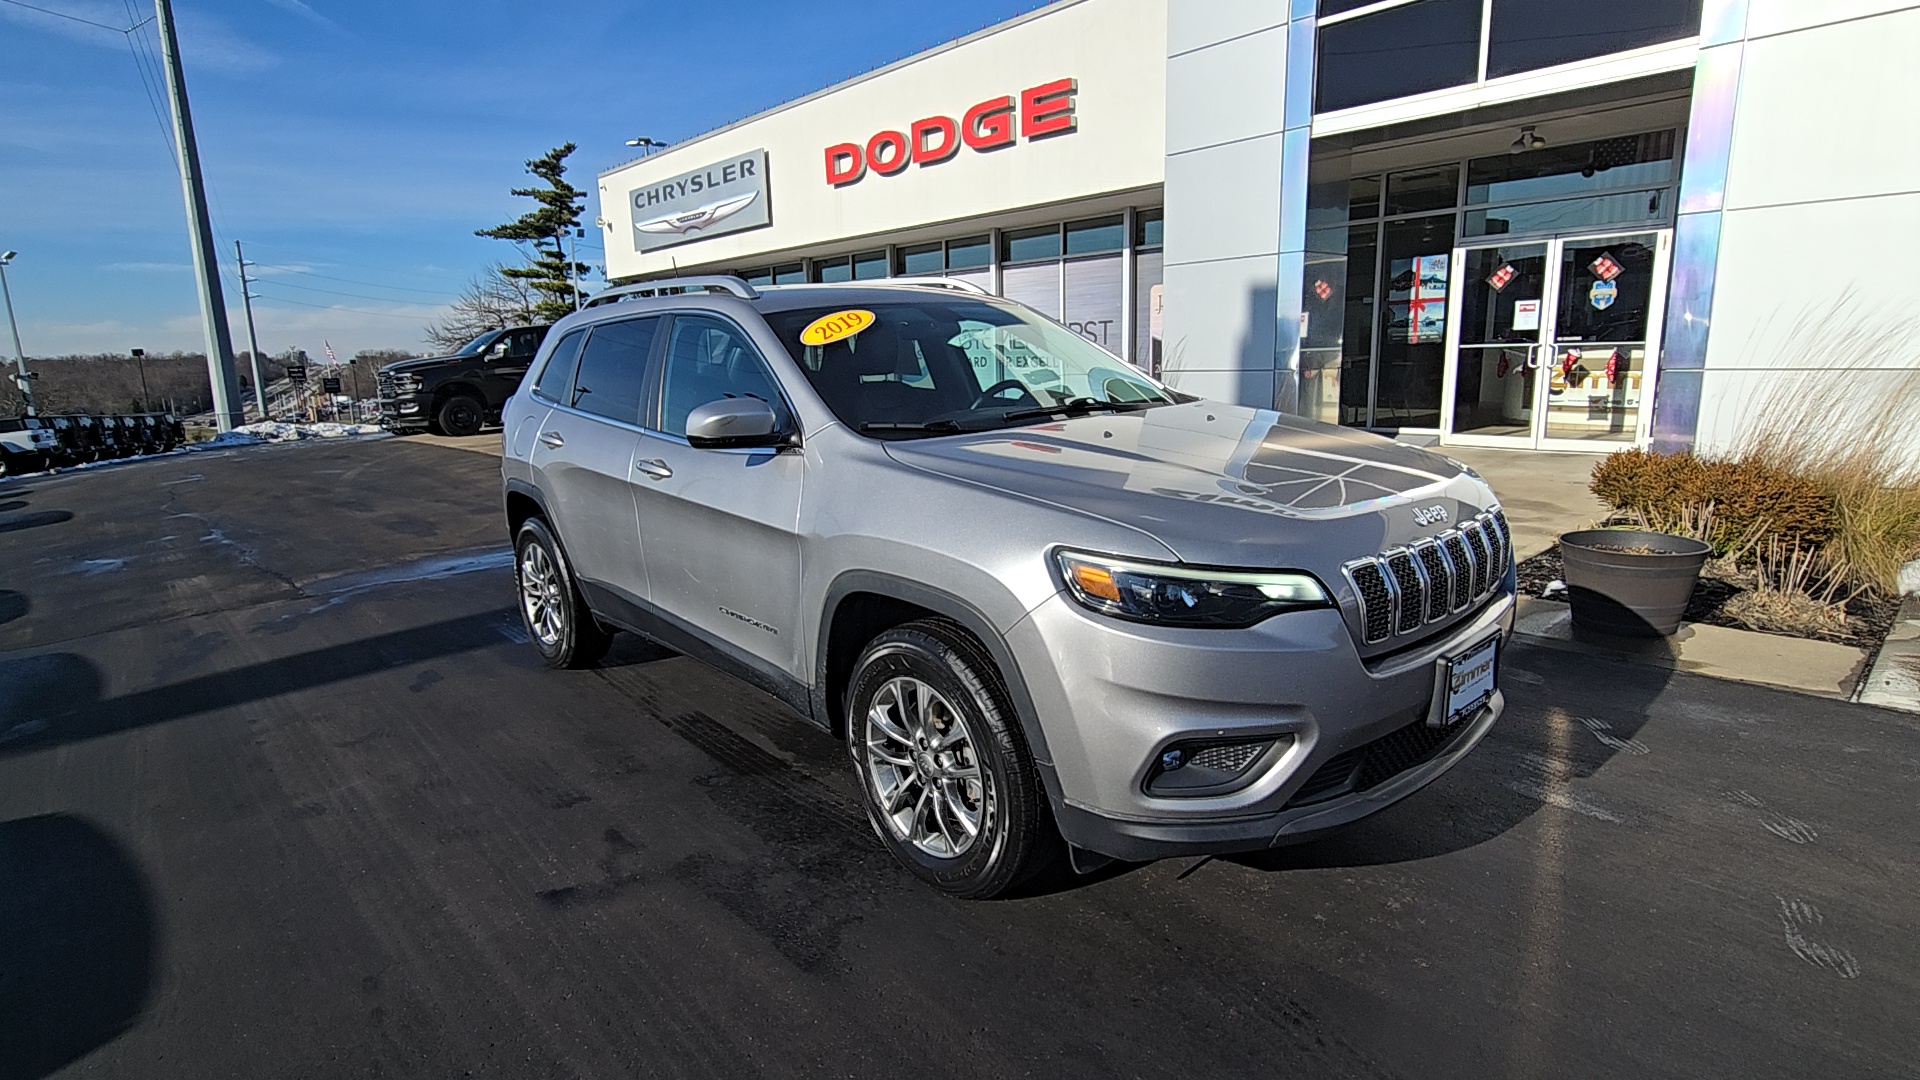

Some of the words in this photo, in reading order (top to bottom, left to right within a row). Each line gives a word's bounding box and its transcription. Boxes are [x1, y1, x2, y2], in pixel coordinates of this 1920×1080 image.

[825, 78, 1076, 186] DODGE
[634, 159, 756, 209] CHRYSLER
[814, 312, 863, 340] 2019
[1411, 504, 1448, 526] Jeep
